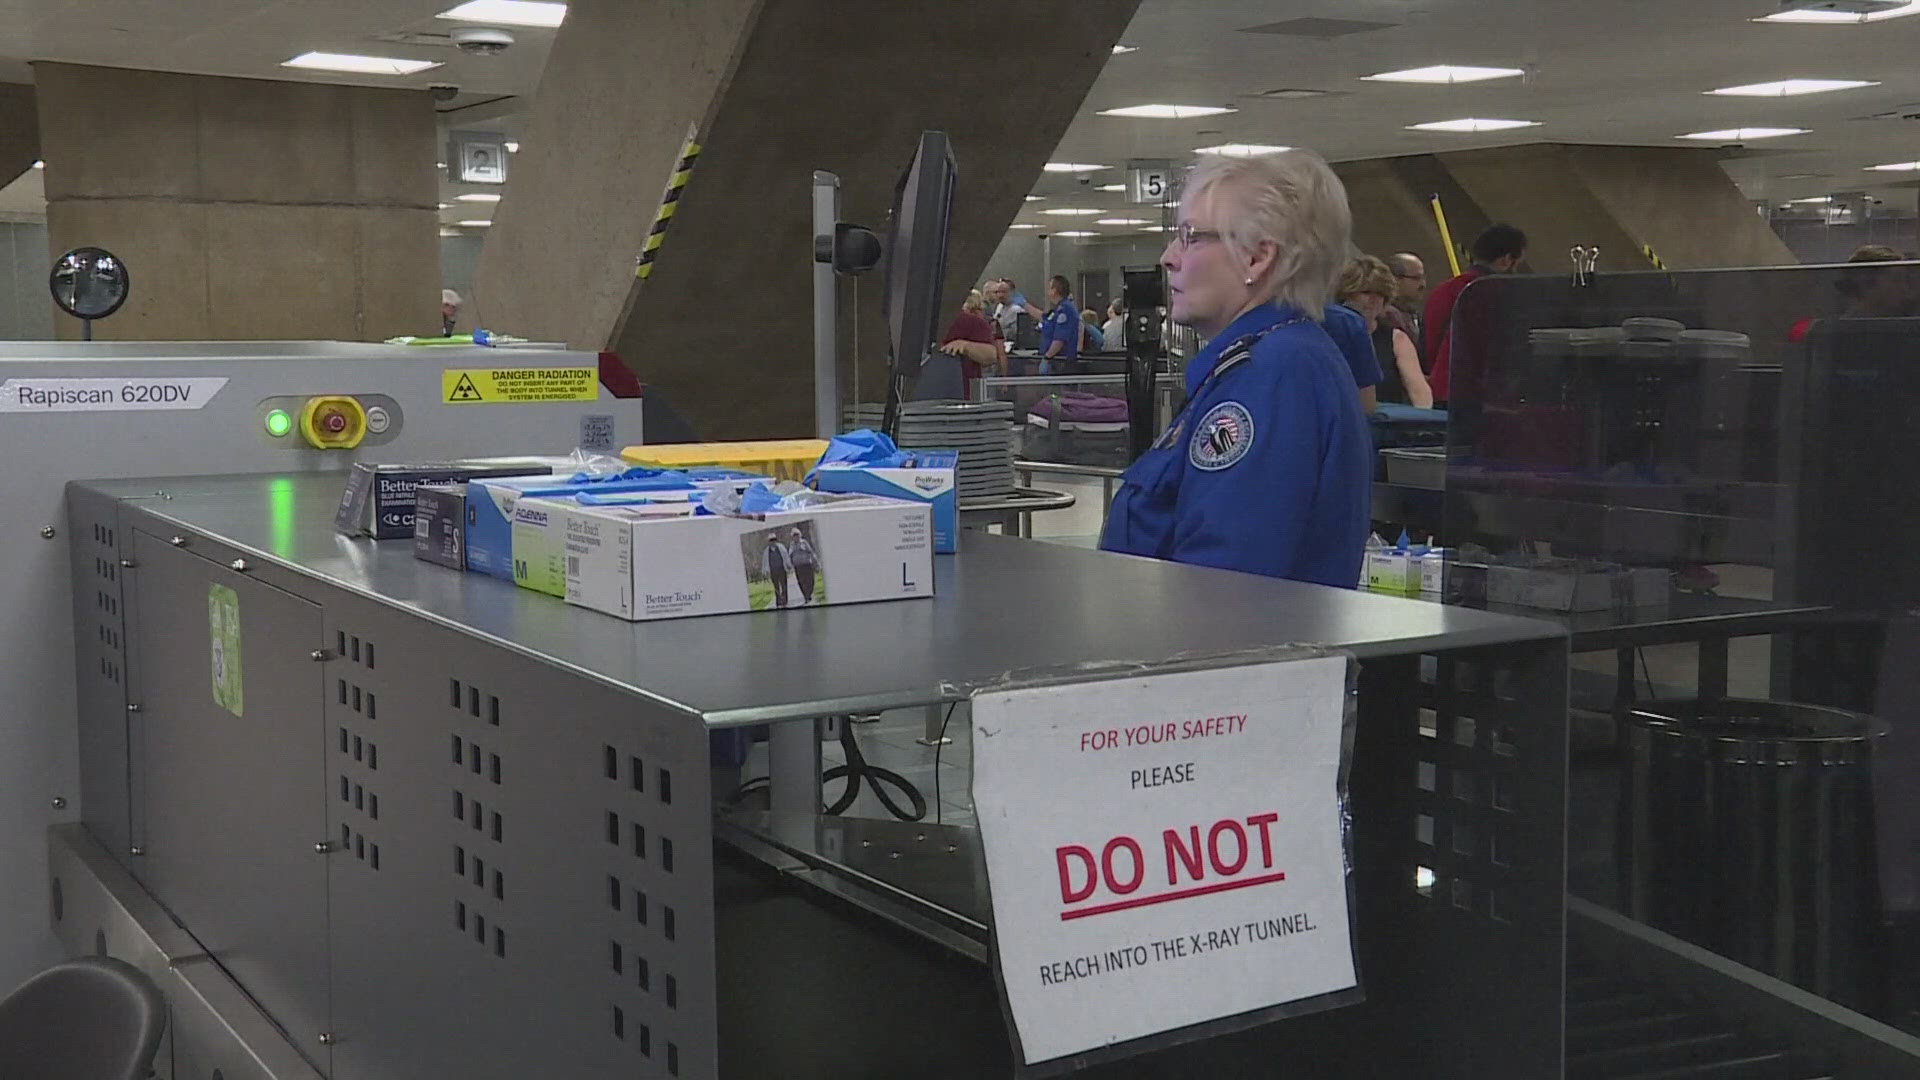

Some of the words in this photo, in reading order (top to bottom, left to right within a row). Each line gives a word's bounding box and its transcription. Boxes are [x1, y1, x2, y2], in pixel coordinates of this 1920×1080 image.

[474, 150, 490, 173] 2
[1149, 175, 1161, 195] 5
[1838, 204, 1847, 217] 7
[492, 371, 535, 380] DANGER
[538, 370, 591, 379] RADIATION
[19, 386, 114, 407] Rapiscan
[121, 385, 191, 402] 620DV
[381, 479, 418, 492] Better
[453, 528, 459, 553] S
[515, 559, 528, 580] M
[903, 562, 915, 586] L
[621, 586, 627, 608] L
[646, 594, 673, 604] Better
[674, 591, 702, 601] Touch
[1081, 730, 1118, 752] FOR
[1125, 723, 1177, 747] YOUR
[1181, 714, 1248, 739] SAFETY
[1131, 763, 1195, 789] PLEASE
[1056, 836, 1144, 904] DO
[1162, 813, 1279, 885] NOT
[1040, 955, 1100, 986] REACH
[1104, 946, 1148, 972] INTO
[1151, 938, 1187, 962] THE
[1190, 926, 1241, 954] X-RAY
[1245, 913, 1317, 940] TUNNEL.
